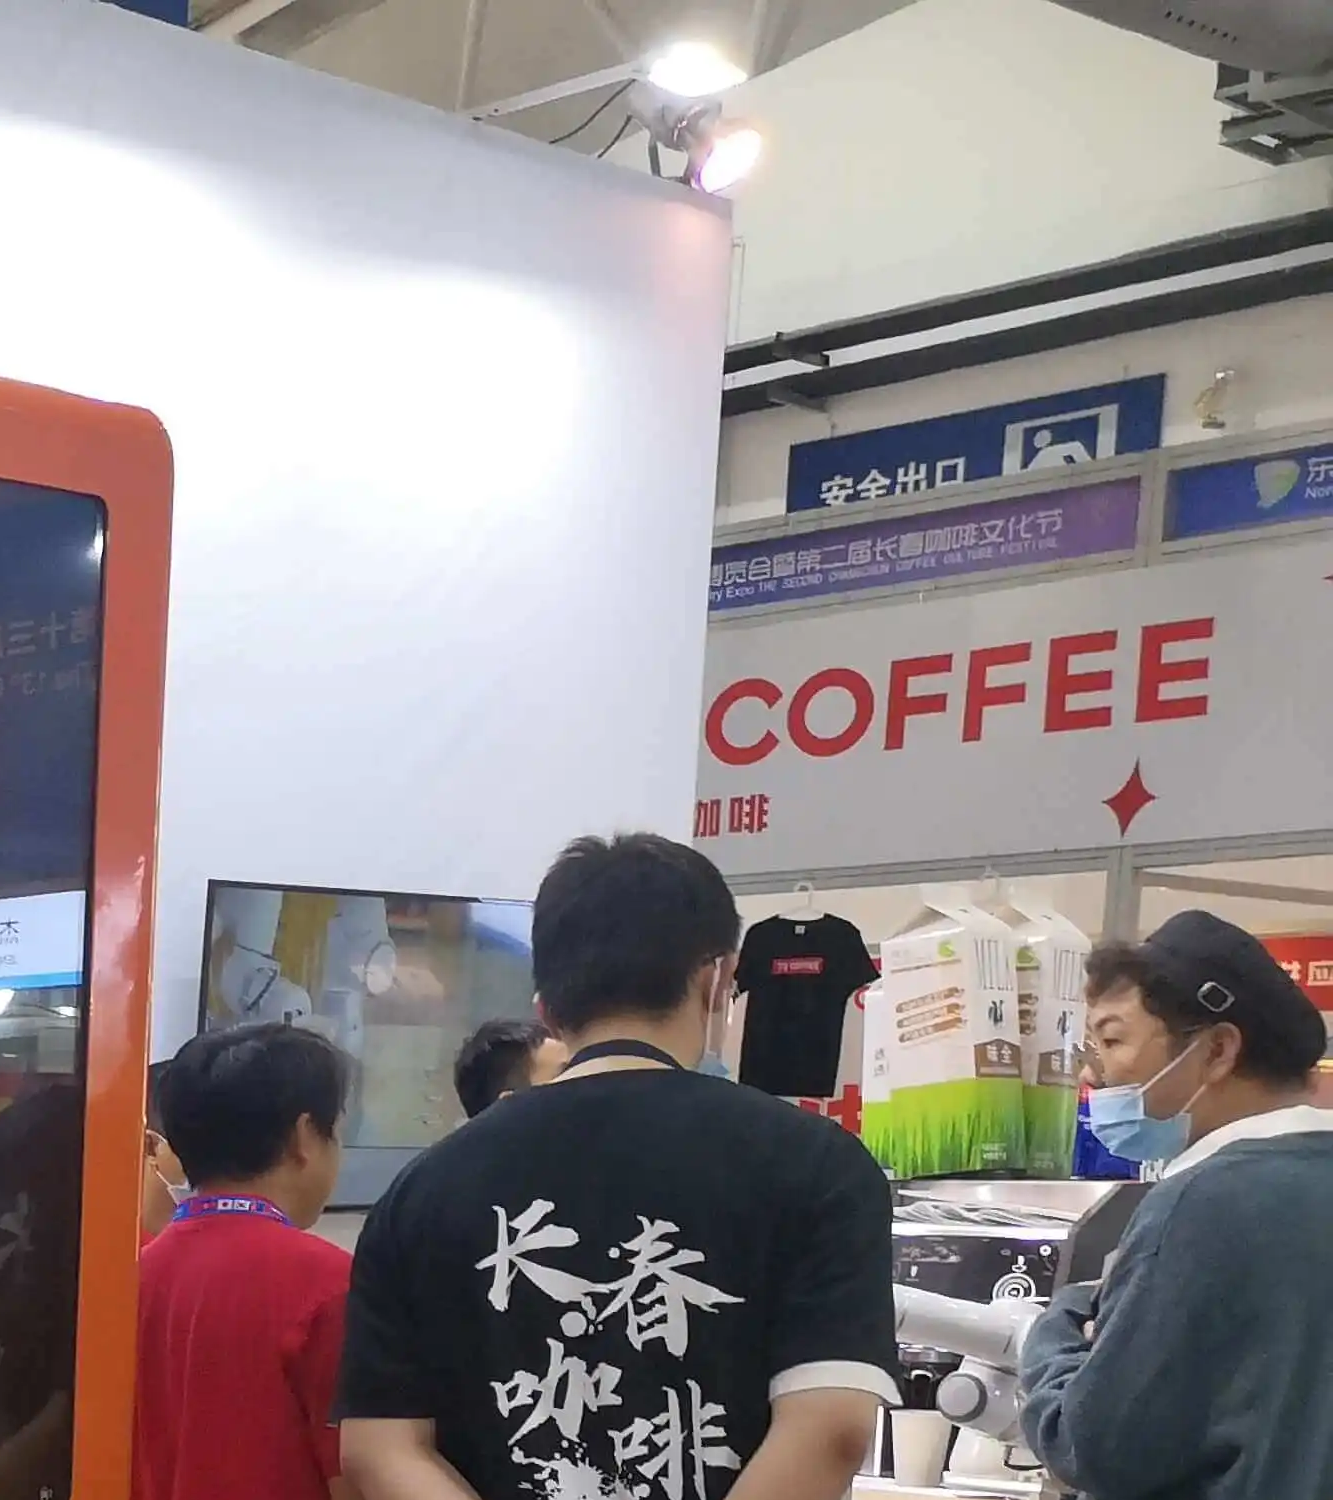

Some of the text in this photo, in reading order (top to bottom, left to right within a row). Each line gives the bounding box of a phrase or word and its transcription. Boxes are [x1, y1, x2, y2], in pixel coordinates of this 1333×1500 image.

[819, 456, 966, 505] 安全出口
[726, 586, 754, 598] Expo
[705, 617, 1214, 765] COFFEE
[475, 1199, 744, 1357] 长春
